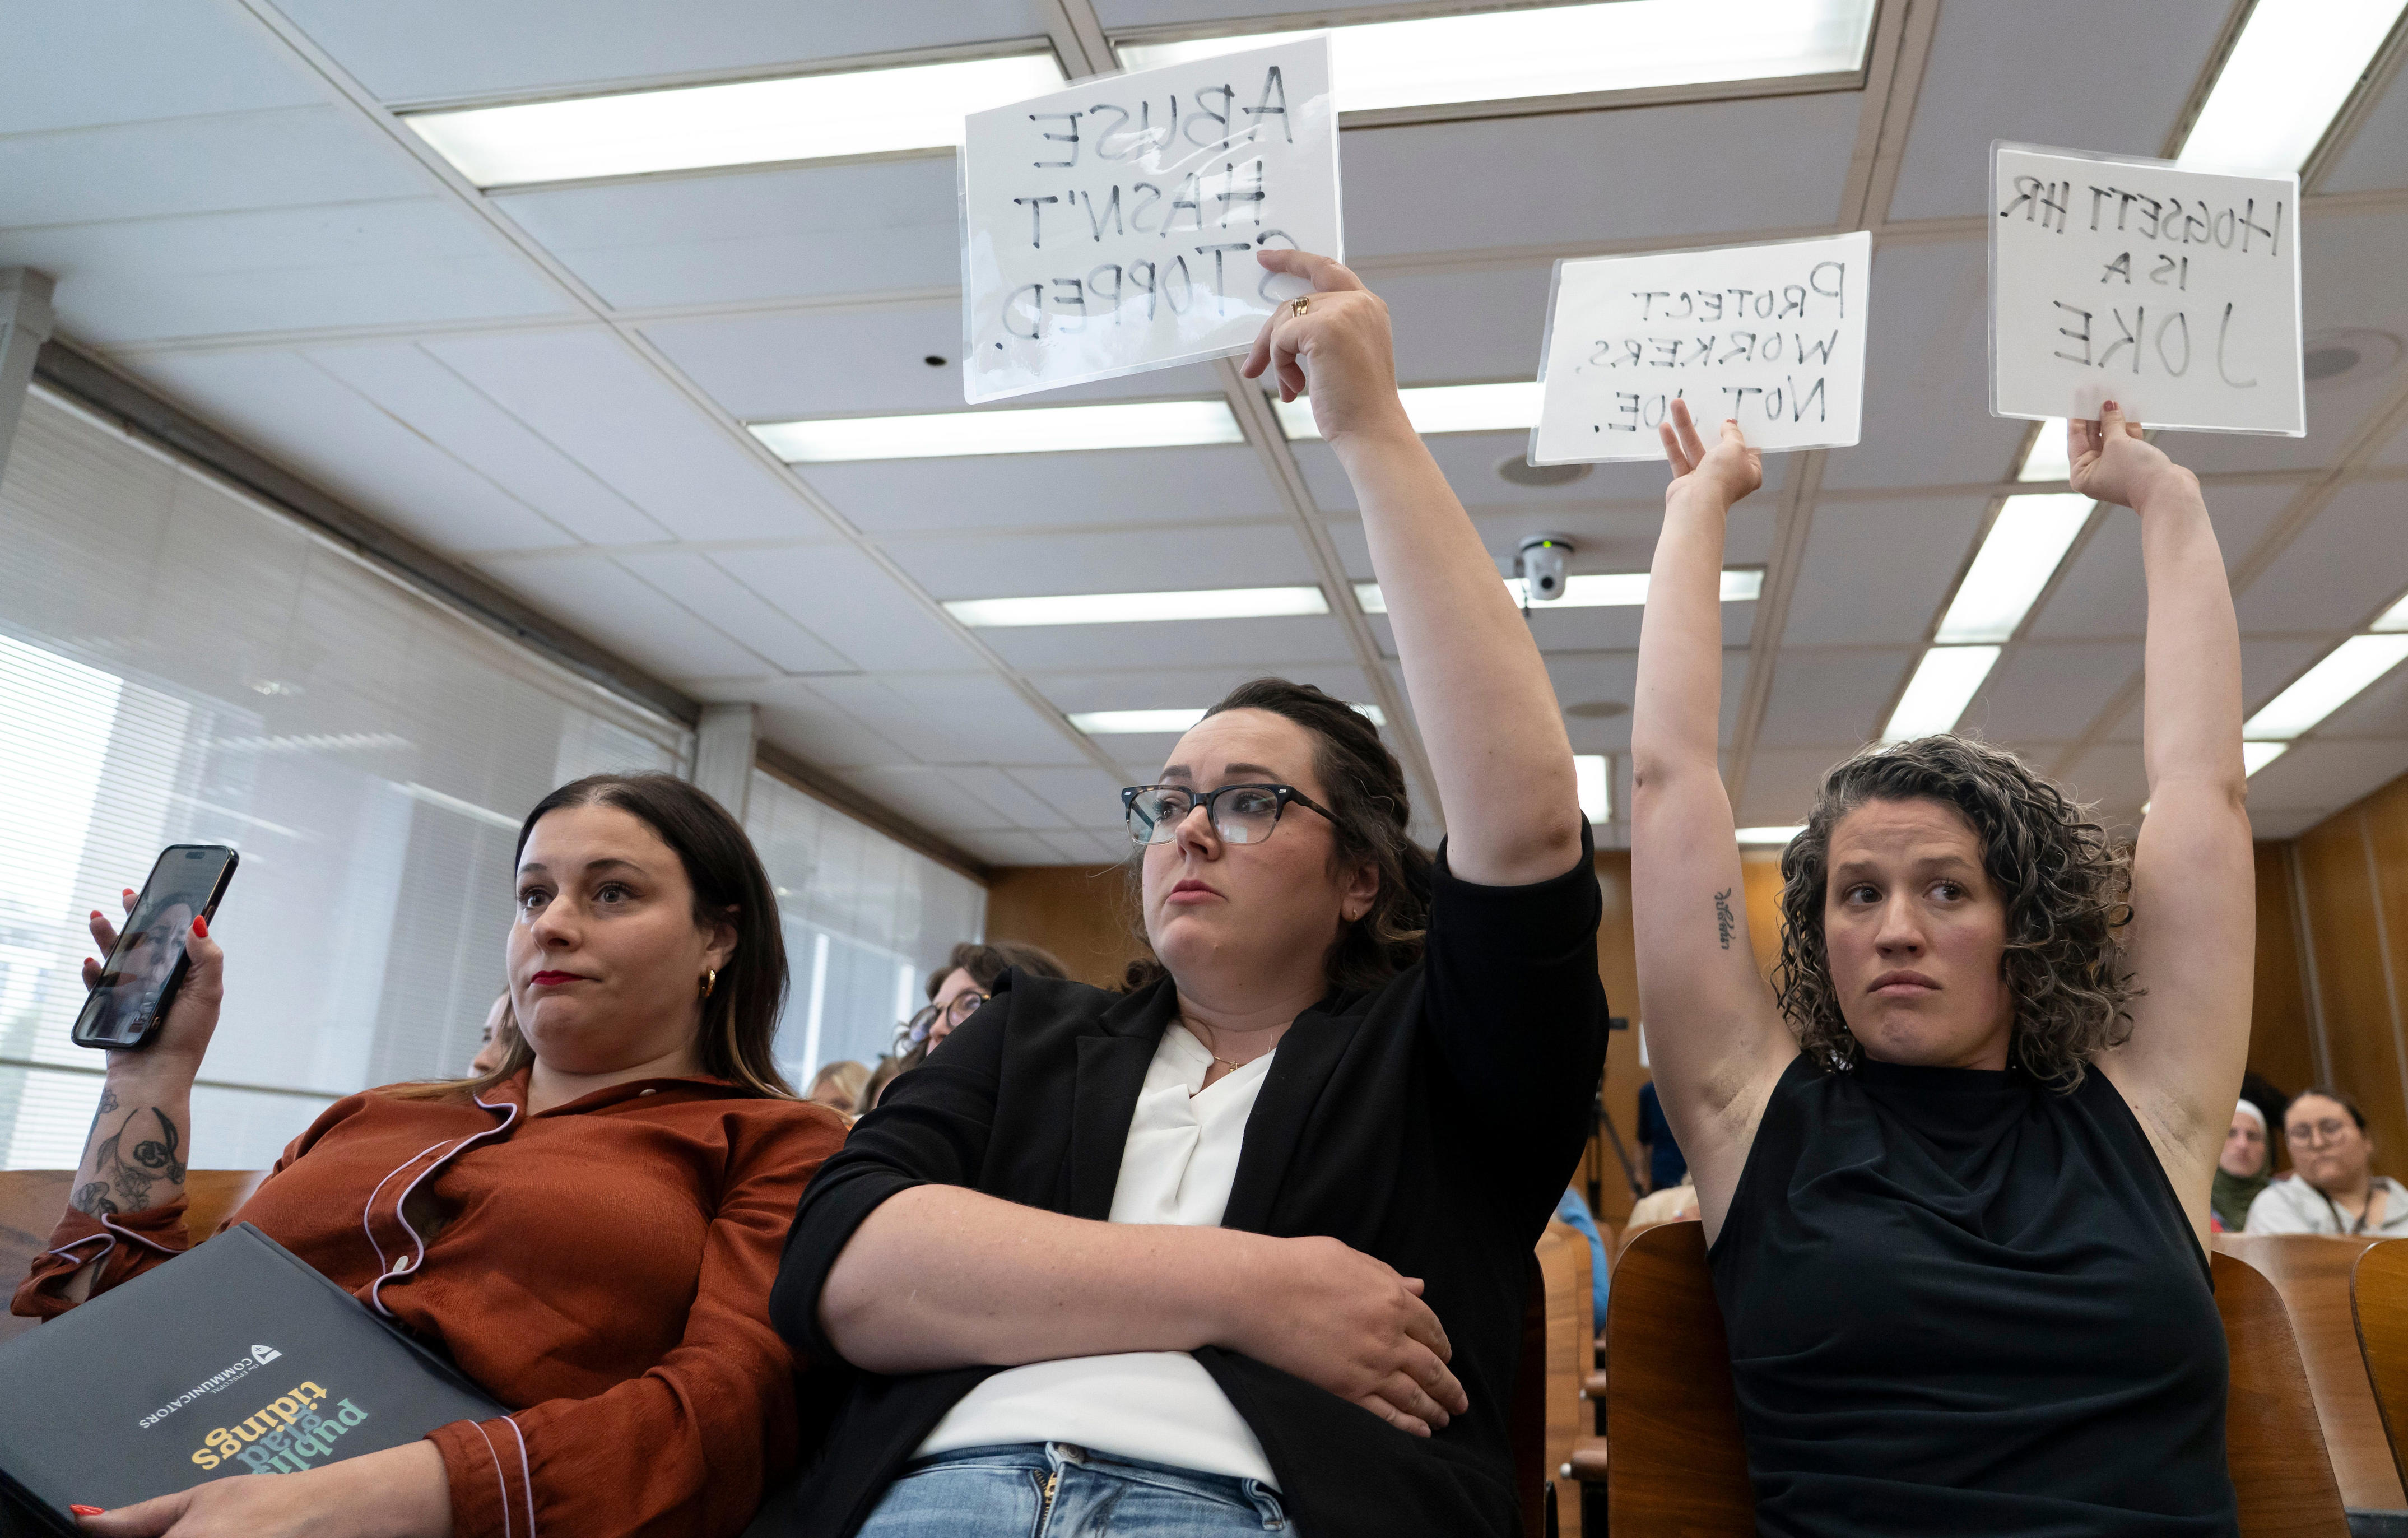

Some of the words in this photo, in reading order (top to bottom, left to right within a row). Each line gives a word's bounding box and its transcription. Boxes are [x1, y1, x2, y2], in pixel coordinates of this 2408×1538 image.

[139, 1358, 252, 1428] COMMUNICATORS
[210, 1370, 249, 1394] EPISCOPAL
[192, 1381, 327, 1470] tidings
[237, 1404, 322, 1474] glad
